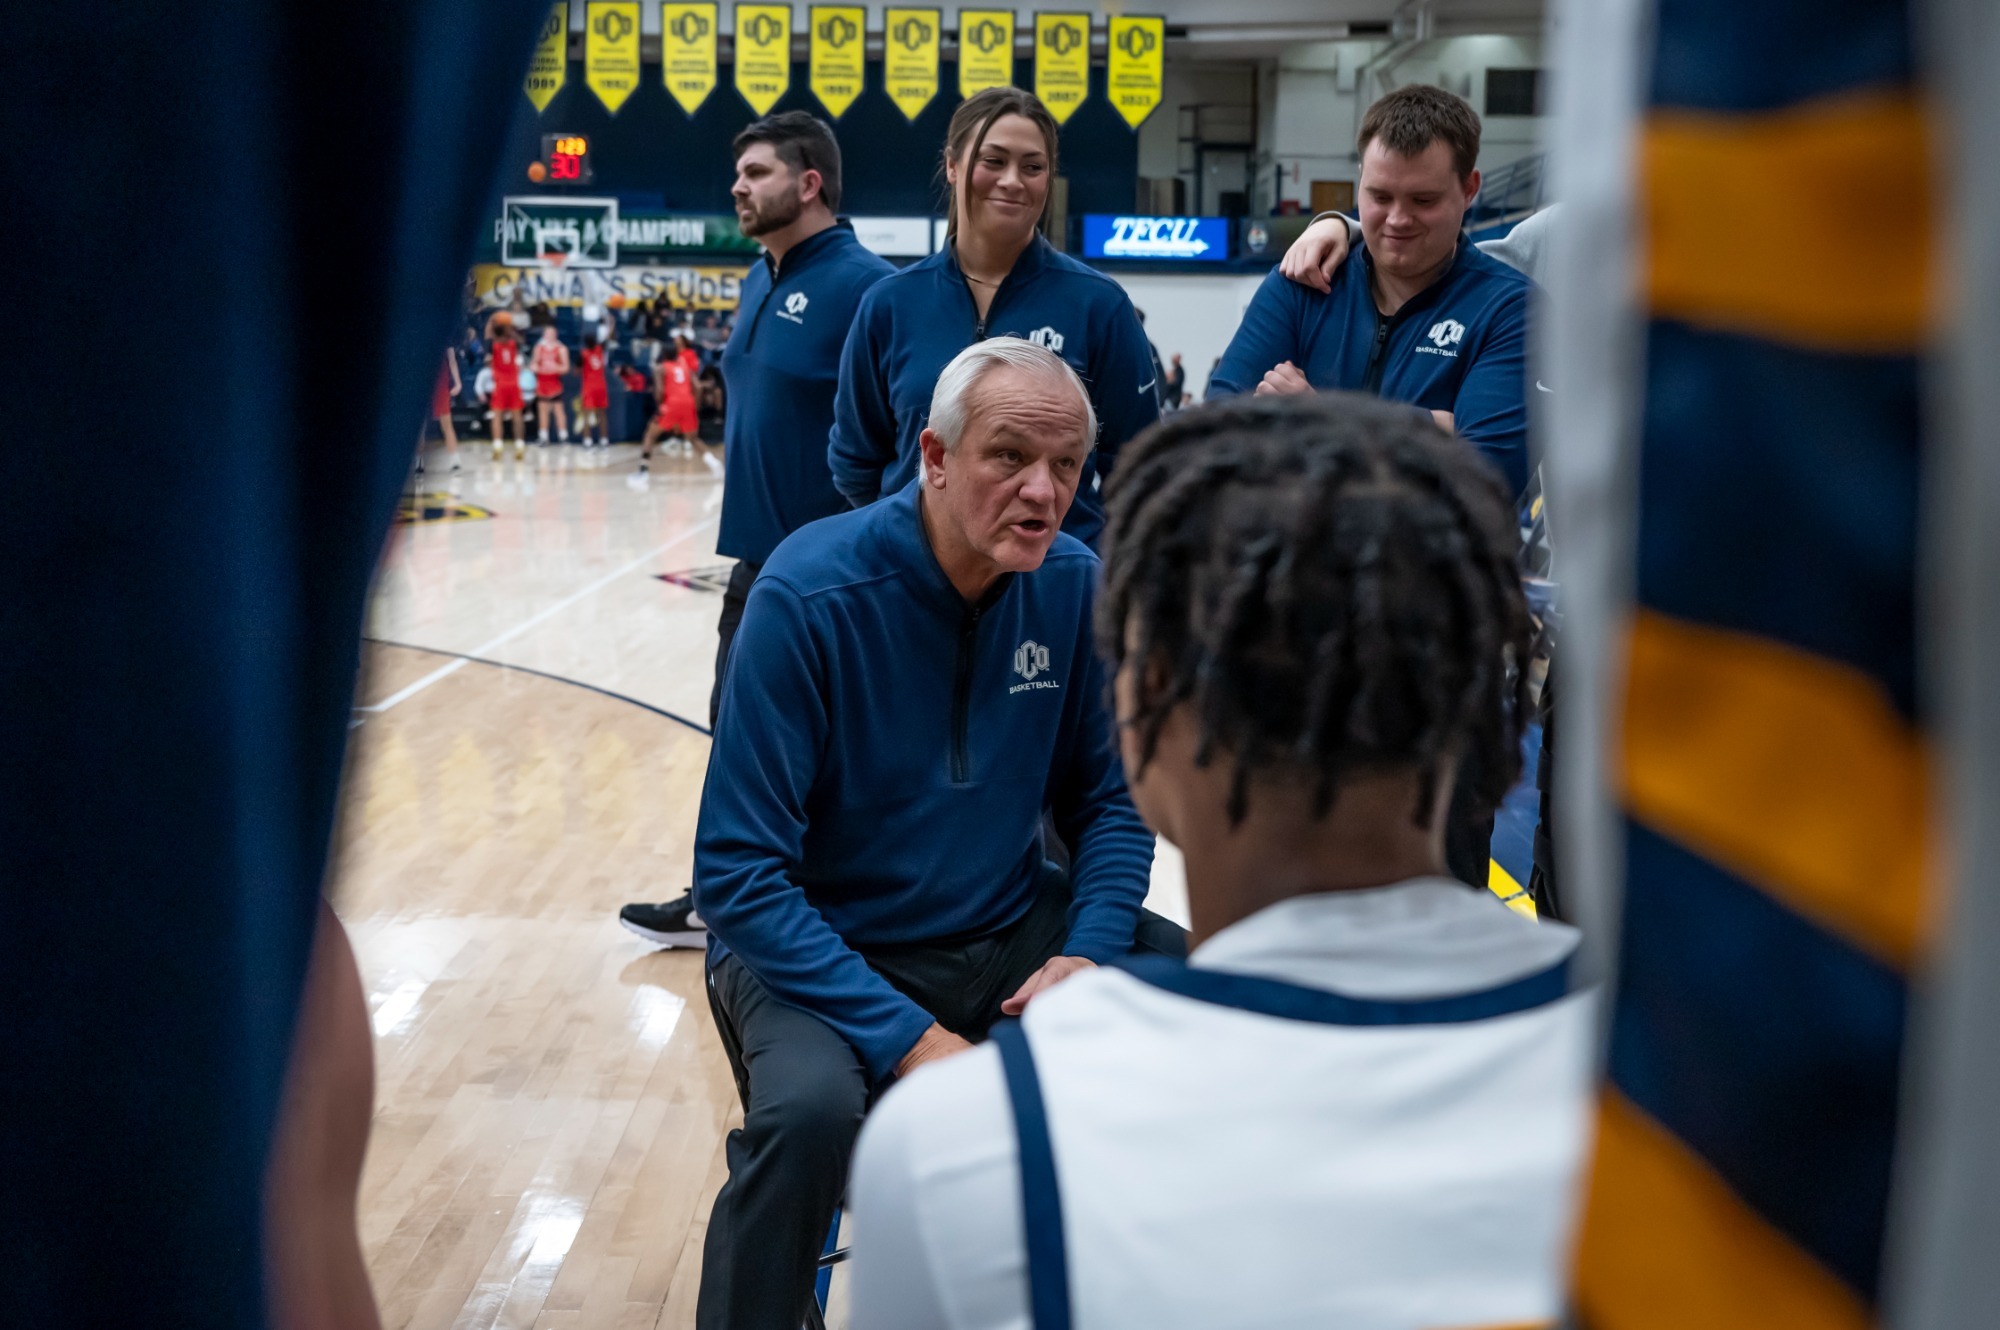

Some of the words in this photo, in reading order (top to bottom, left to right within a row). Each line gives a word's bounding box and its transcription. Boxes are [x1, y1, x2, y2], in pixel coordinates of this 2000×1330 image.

[550, 153, 581, 179] 30
[1428, 318, 1466, 348] UCO
[1415, 345, 1459, 358] BASKETBALL
[1013, 639, 1051, 682] UCO
[1009, 680, 1060, 695] BASKETBALL
